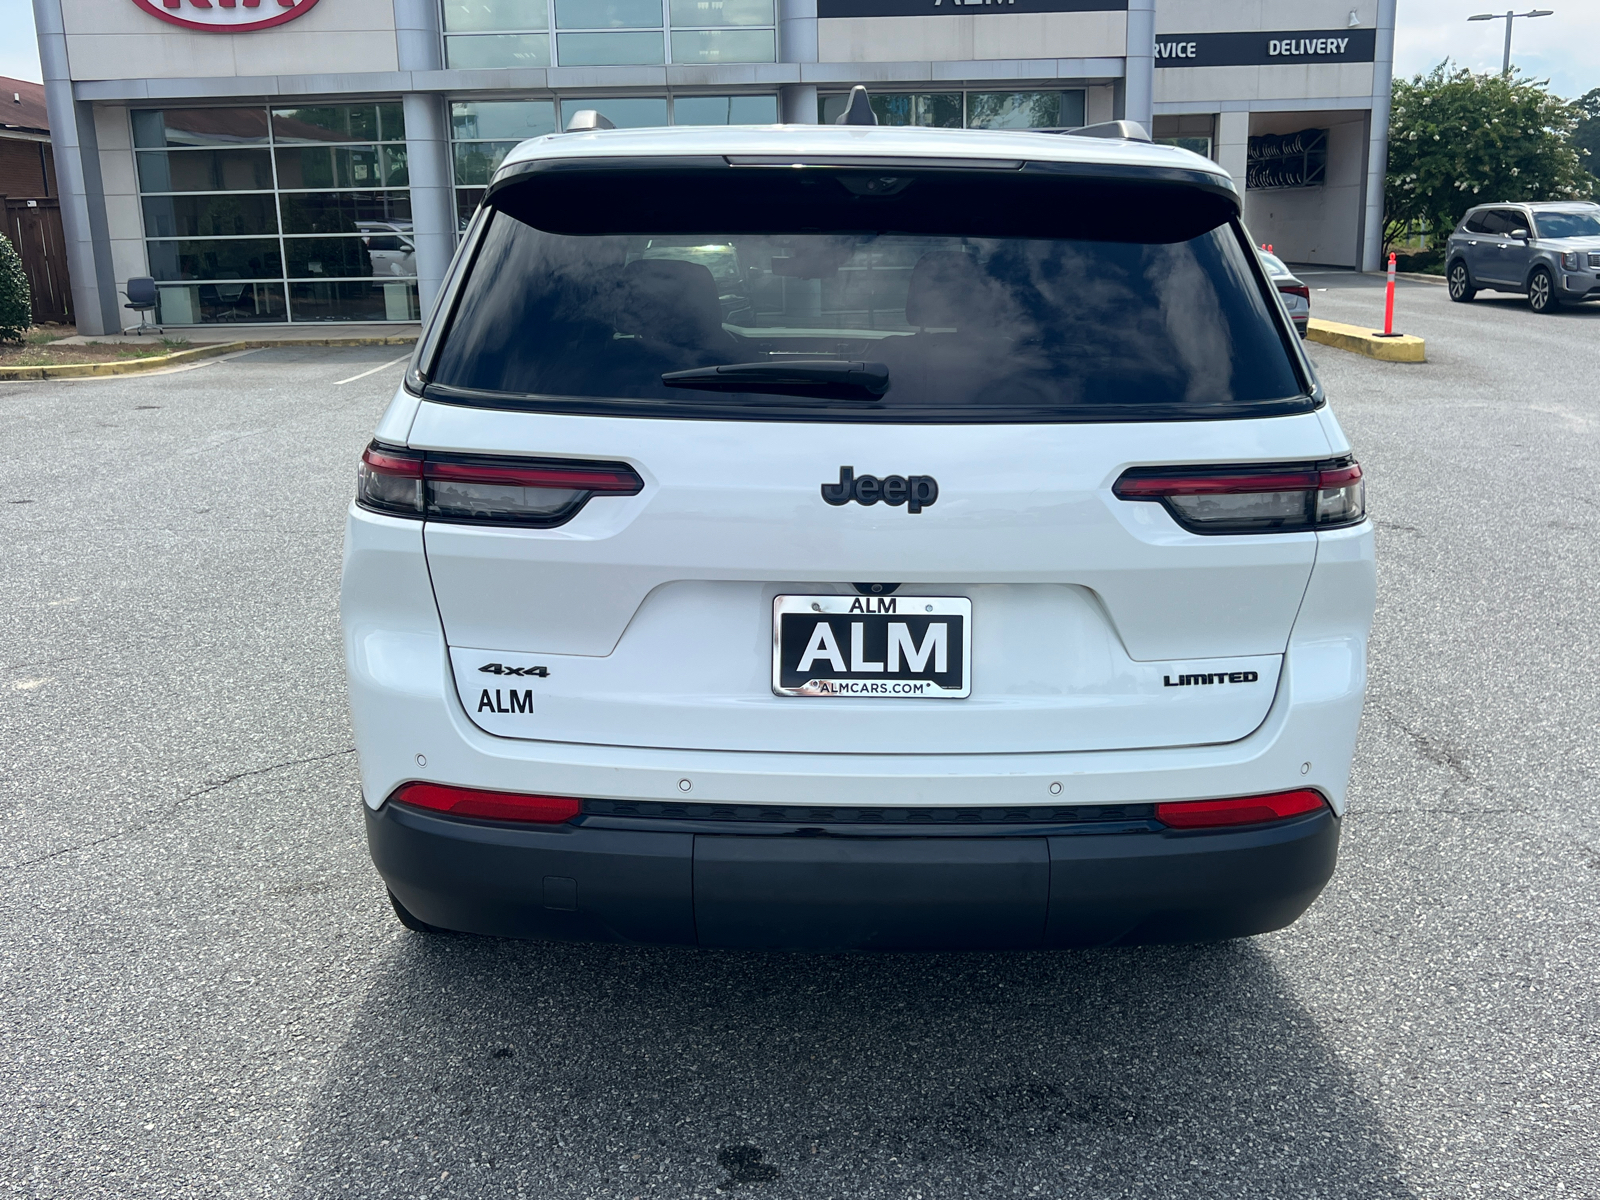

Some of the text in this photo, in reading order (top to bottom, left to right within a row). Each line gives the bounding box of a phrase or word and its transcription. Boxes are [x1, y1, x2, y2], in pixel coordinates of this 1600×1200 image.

[1269, 38, 1349, 56] DELIVERY
[821, 466, 939, 514] Jeep
[849, 597, 897, 613] ALM
[796, 622, 948, 673] ALM
[478, 663, 551, 678] 4x4
[1163, 671, 1259, 687] LIMITED
[820, 682, 924, 694] ALMCARS.COM
[477, 689, 534, 714] ALM
